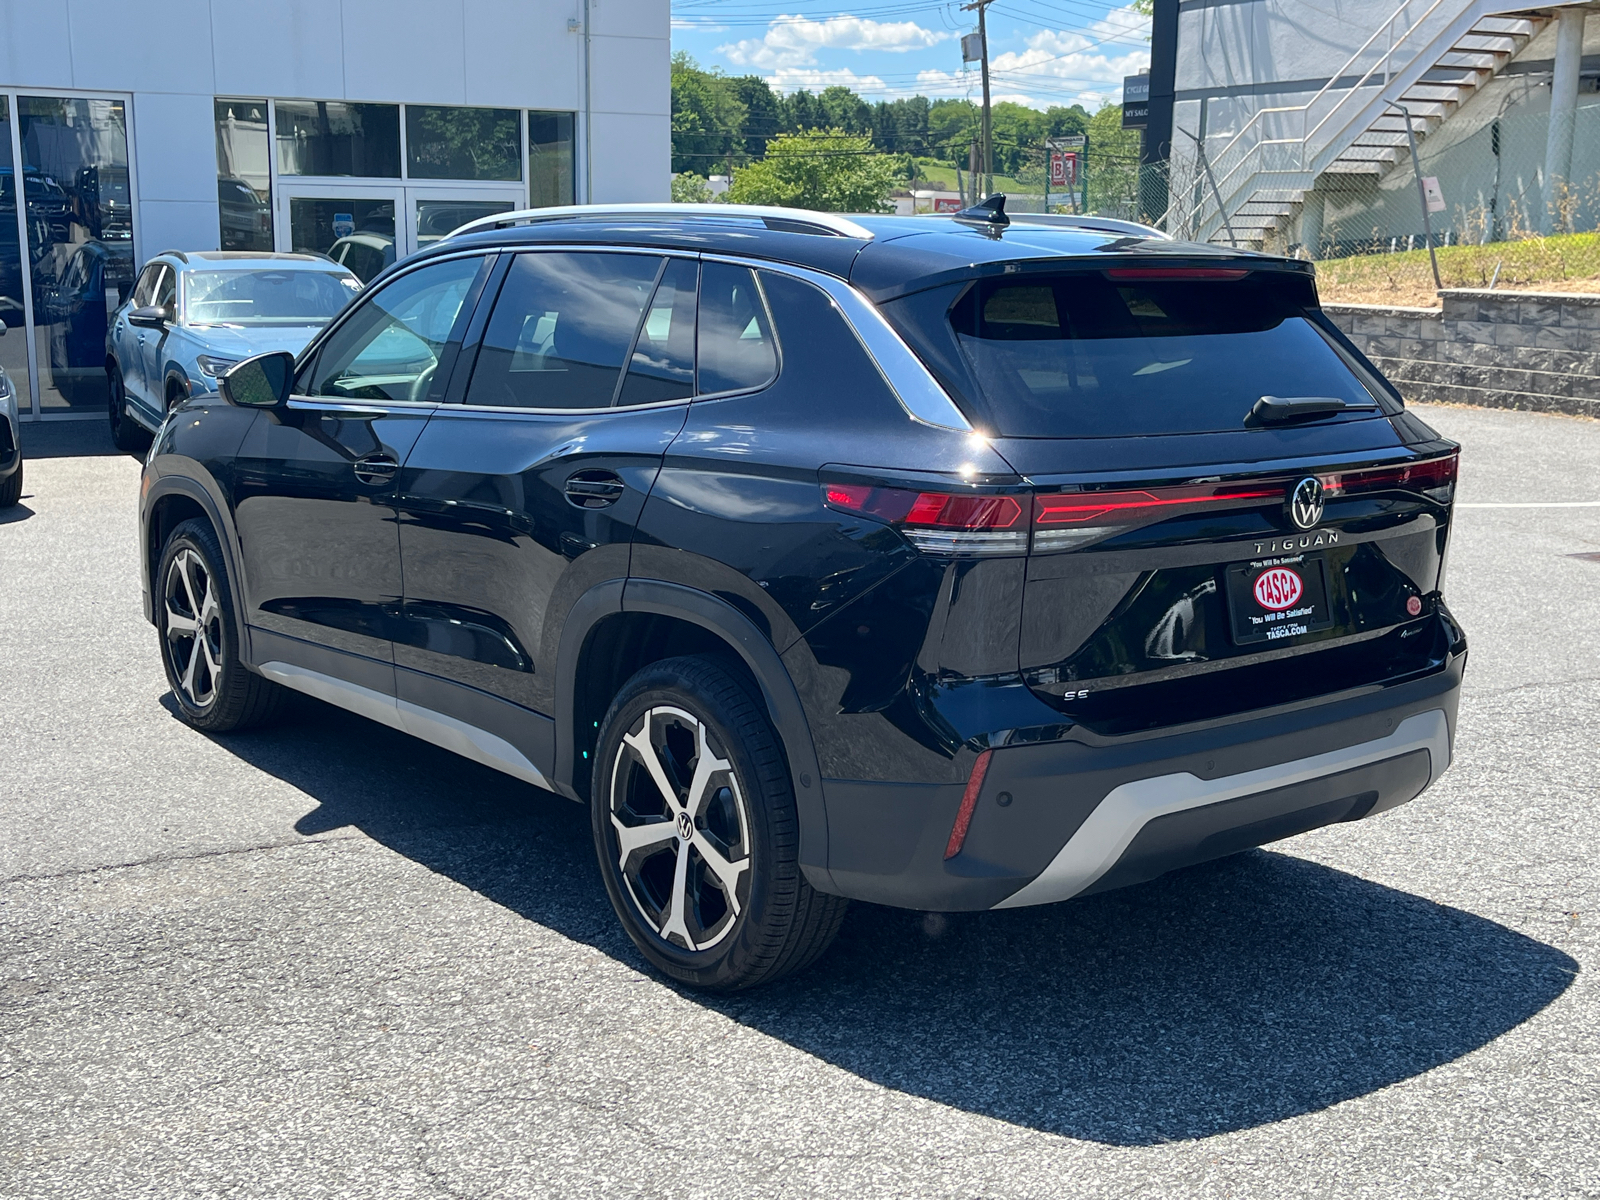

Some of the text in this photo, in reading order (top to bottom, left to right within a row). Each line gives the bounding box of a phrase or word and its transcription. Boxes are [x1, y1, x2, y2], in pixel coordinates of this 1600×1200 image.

[1126, 85, 1142, 94] CYCLE
[1254, 533, 1338, 554] TIGUAN
[1259, 572, 1297, 605] TASCA
[1264, 612, 1276, 622] Will
[1277, 611, 1285, 620] Be
[1266, 625, 1307, 640] TASCA.COM
[1063, 689, 1089, 701] SE
